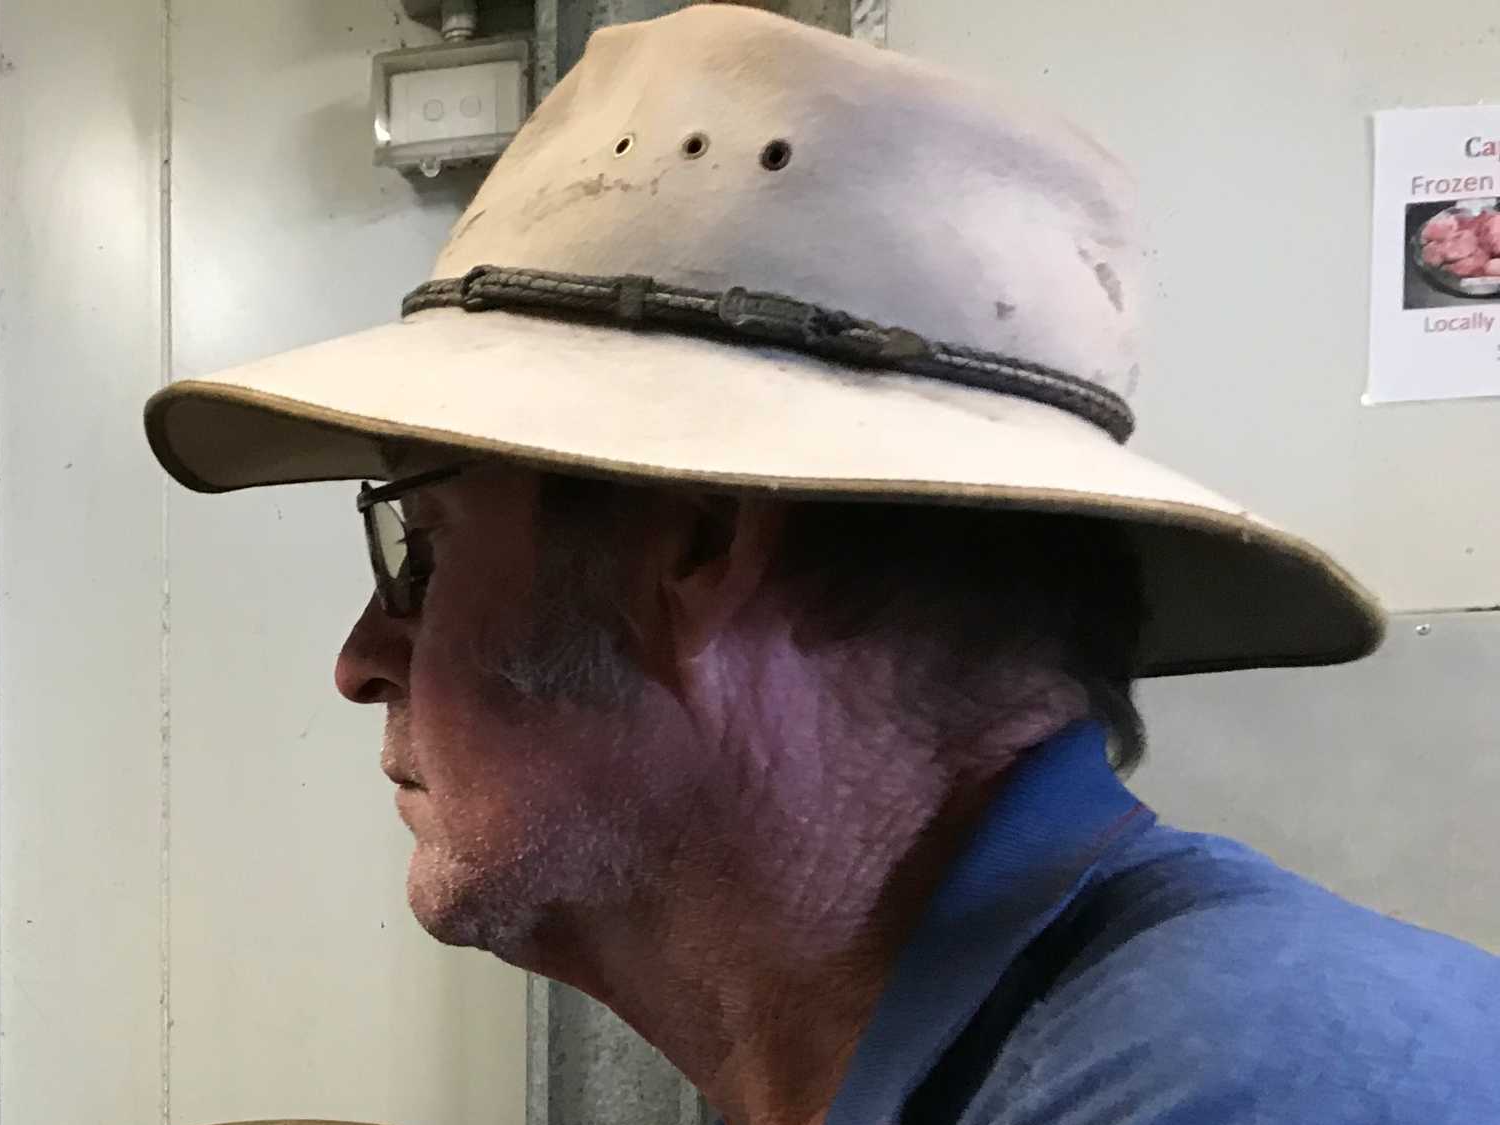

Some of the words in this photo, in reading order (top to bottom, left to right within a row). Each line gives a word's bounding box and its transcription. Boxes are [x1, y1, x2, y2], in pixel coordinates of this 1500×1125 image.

[1464, 136, 1500, 159] Ca
[1411, 174, 1493, 196] Frozen
[1423, 311, 1495, 333] Locally
